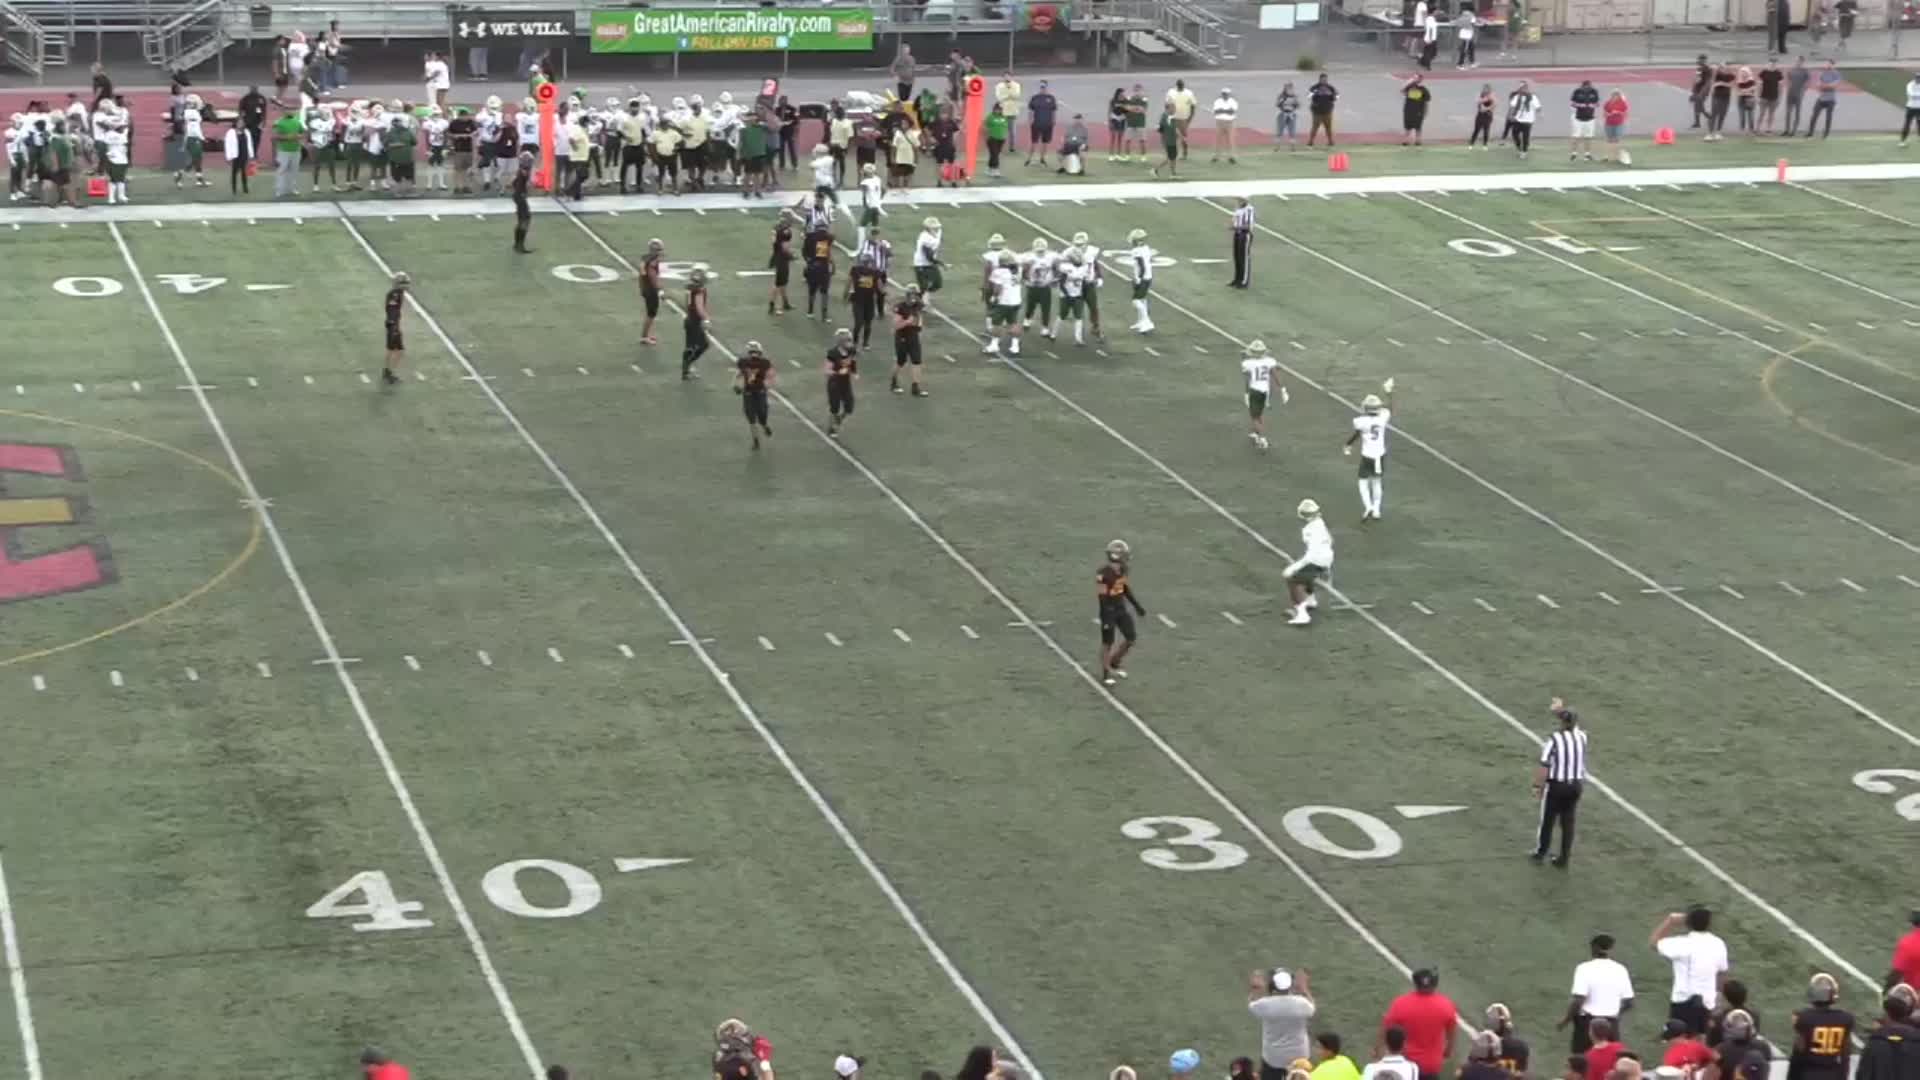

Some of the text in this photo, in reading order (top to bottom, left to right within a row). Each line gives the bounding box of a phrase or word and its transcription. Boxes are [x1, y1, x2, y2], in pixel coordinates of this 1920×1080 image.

[490, 22, 518, 35] WE
[634, 11, 832, 37] GreatAmericanRivalry.com
[692, 35, 749, 48] FOLLOW
[1254, 367, 1269, 381] 12
[1370, 425, 1380, 441] 5
[1120, 805, 1403, 870] 30
[305, 859, 603, 931] 40
[1810, 1027, 1847, 1054] 90
